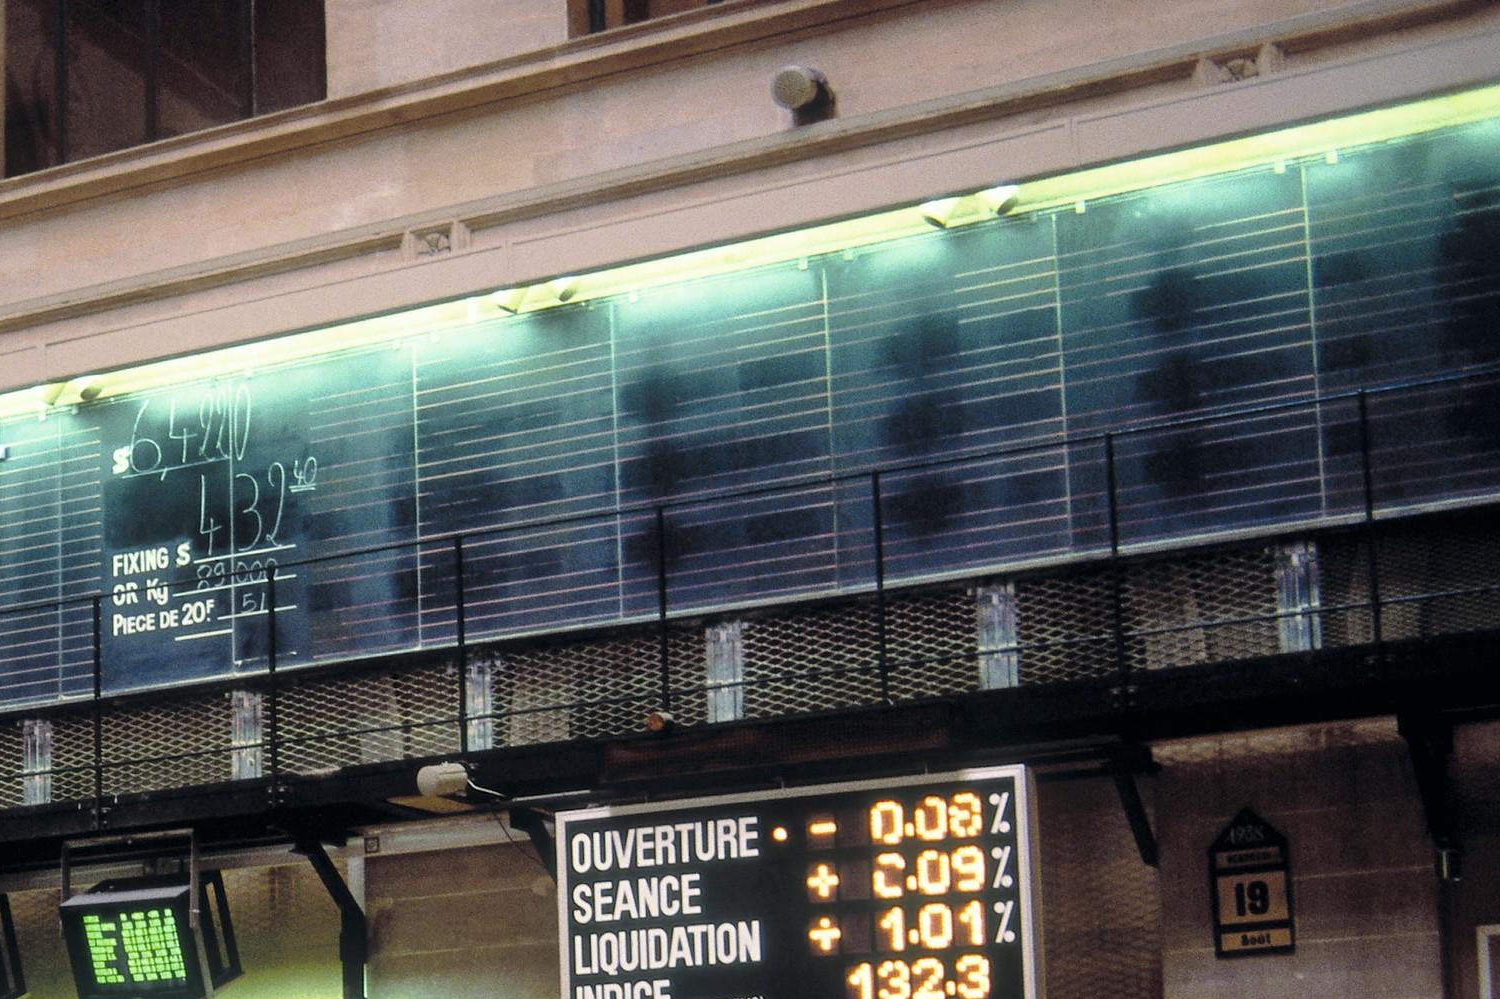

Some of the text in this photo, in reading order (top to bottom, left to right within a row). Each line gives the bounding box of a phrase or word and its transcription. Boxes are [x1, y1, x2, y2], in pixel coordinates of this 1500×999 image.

[113, 547, 169, 577] FIXING
[113, 582, 139, 606] OR
[160, 609, 179, 630] DE
[571, 816, 760, 874] OUVERTURE
[572, 873, 702, 924] SEANCE
[1236, 880, 1269, 916] 19
[878, 900, 986, 952] 1.01
[574, 920, 761, 977] LIQUIDATION
